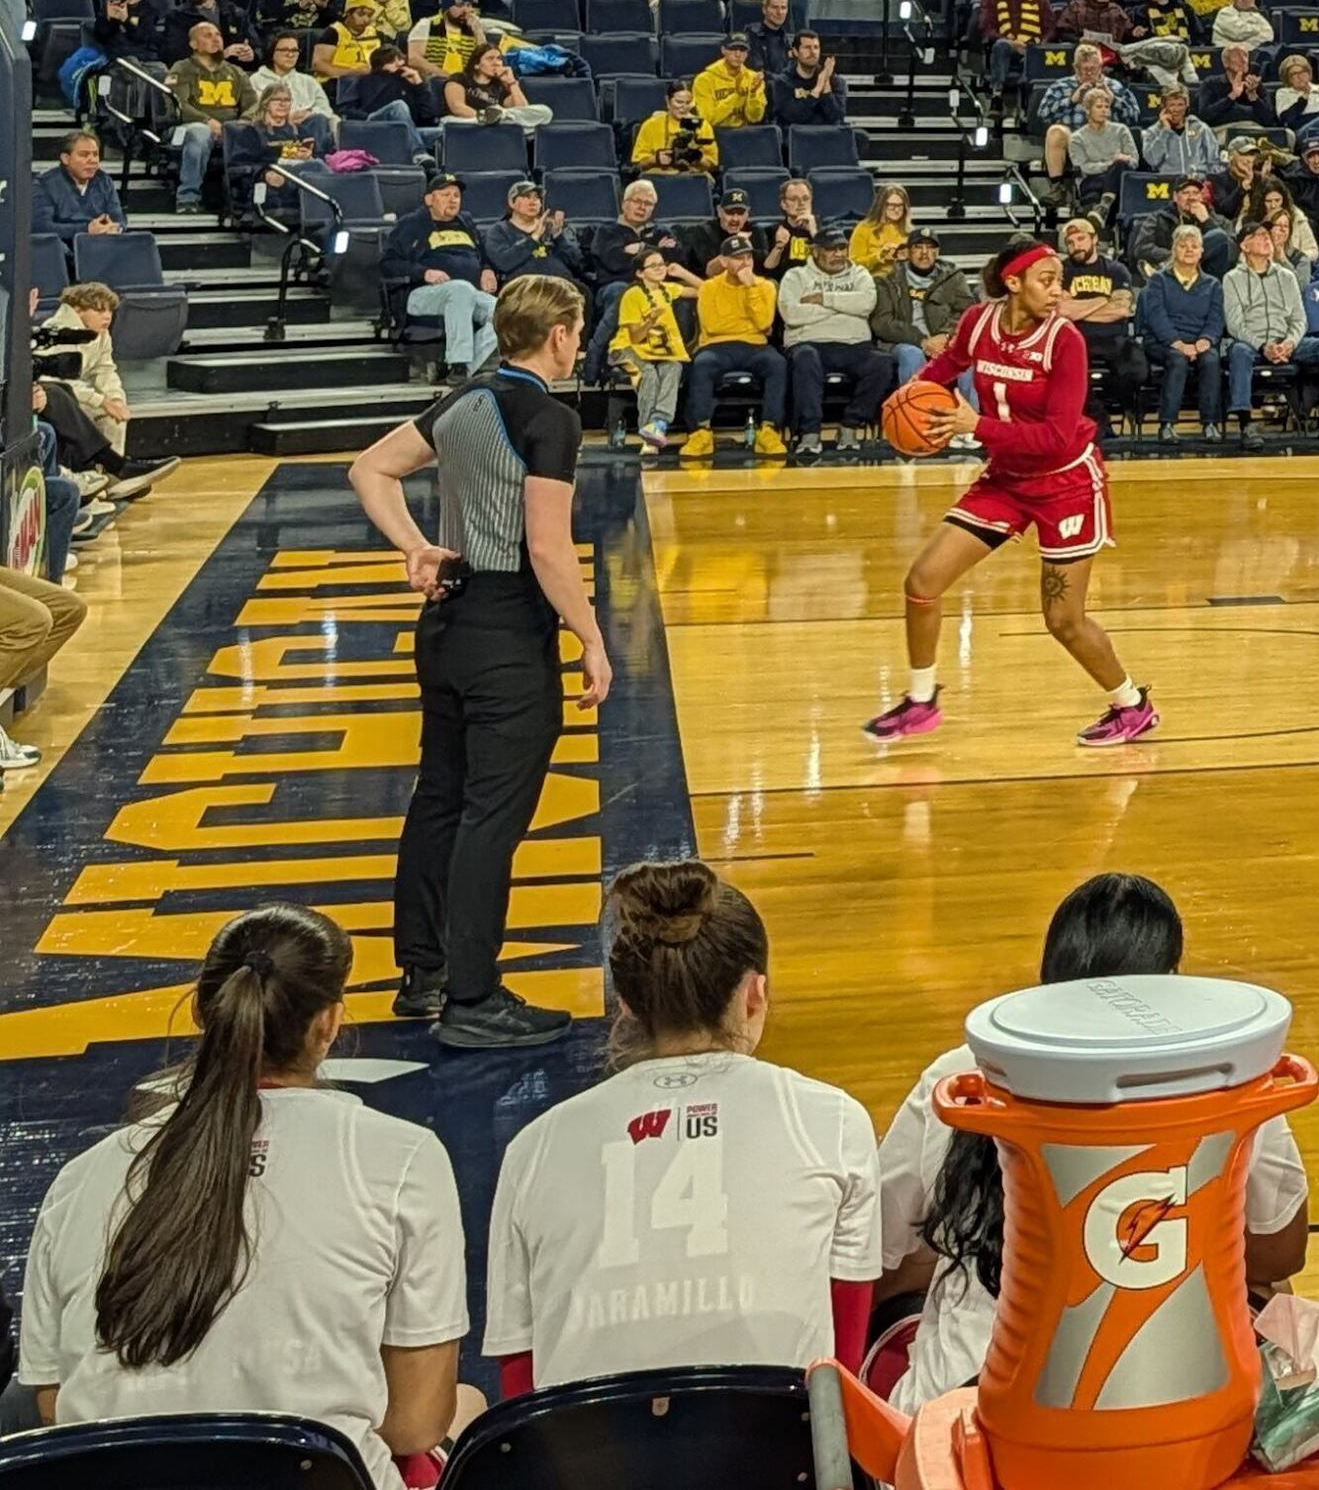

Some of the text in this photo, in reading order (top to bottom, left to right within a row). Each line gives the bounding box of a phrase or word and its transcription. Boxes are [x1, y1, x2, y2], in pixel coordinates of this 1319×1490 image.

[199, 81, 234, 106] M
[993, 382, 1012, 423] 1
[1058, 514, 1085, 539] W
[627, 1109, 673, 1145] W
[686, 1115, 718, 1139] US
[599, 1135, 729, 1270] 14
[1084, 1165, 1190, 1290] G
